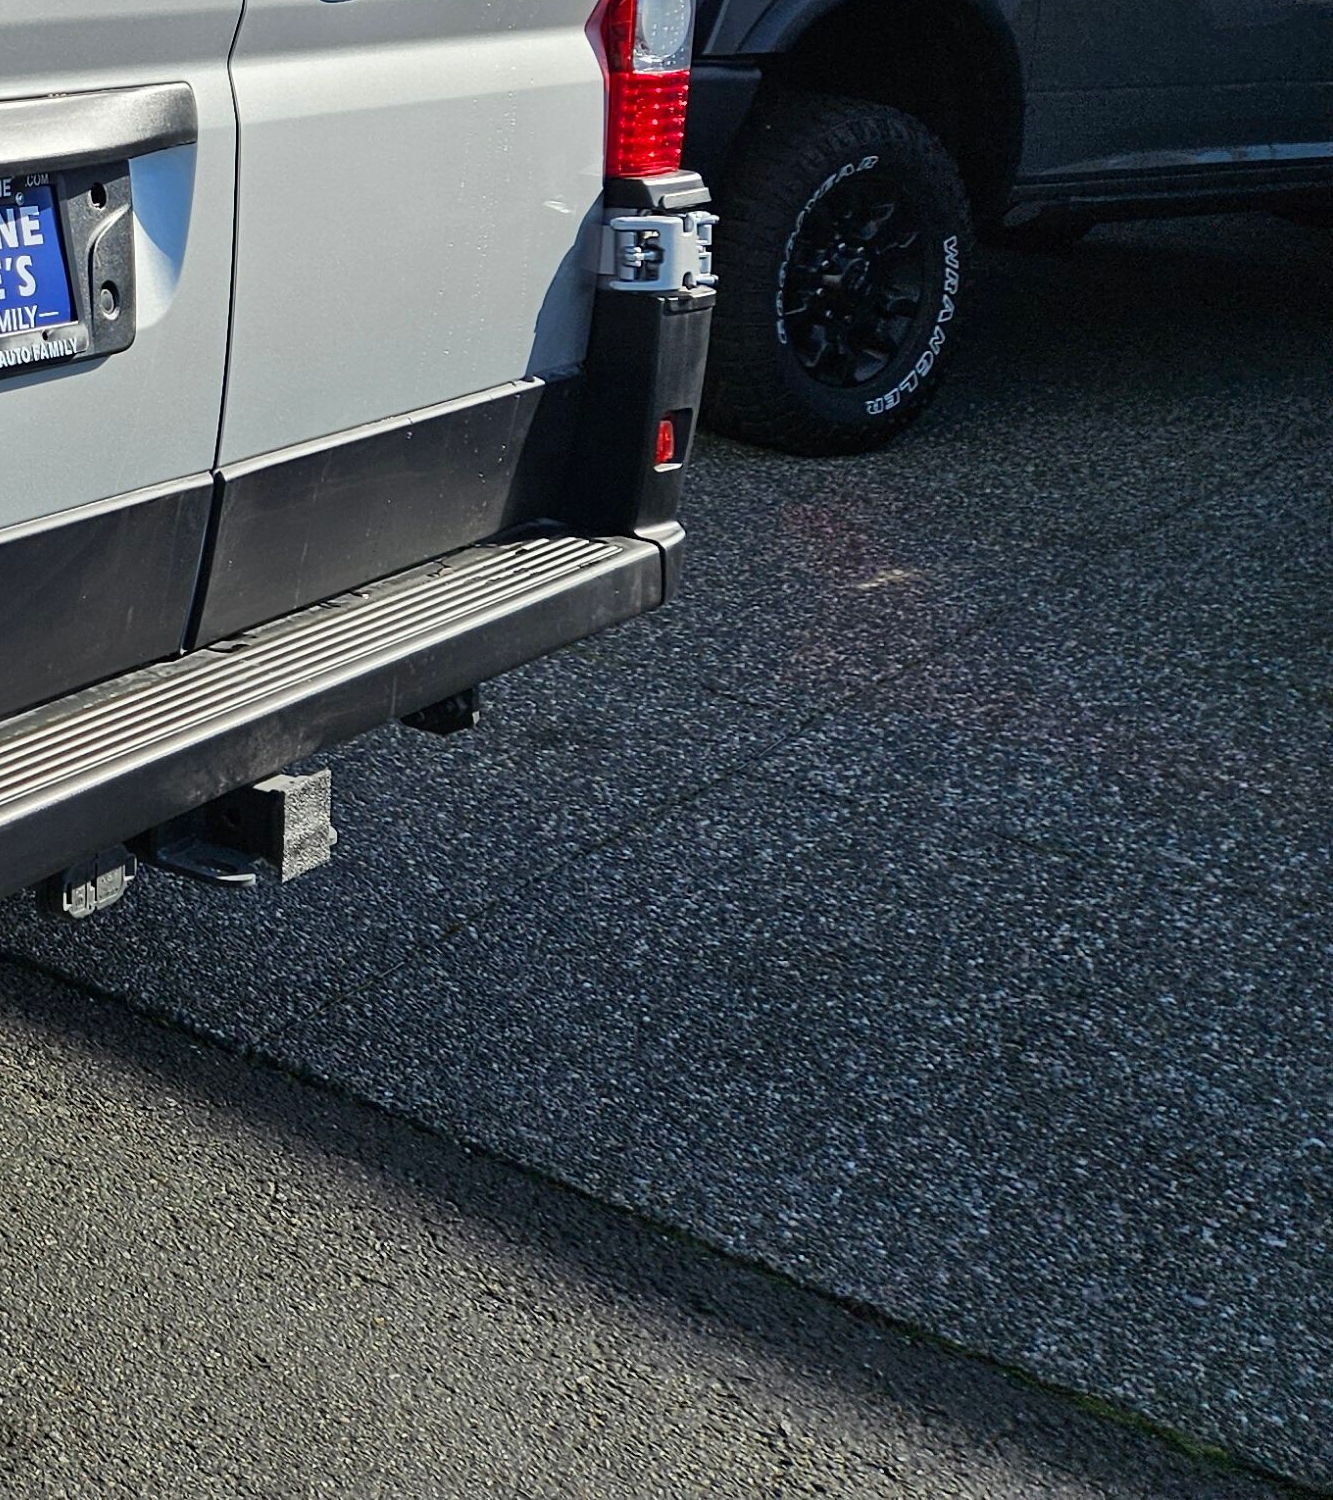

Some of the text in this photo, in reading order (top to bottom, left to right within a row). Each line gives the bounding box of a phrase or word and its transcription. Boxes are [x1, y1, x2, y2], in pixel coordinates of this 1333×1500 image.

[25, 173, 49, 188] .COM
[864, 235, 960, 415] WRANGLER
[32, 338, 78, 361] FAMILY
